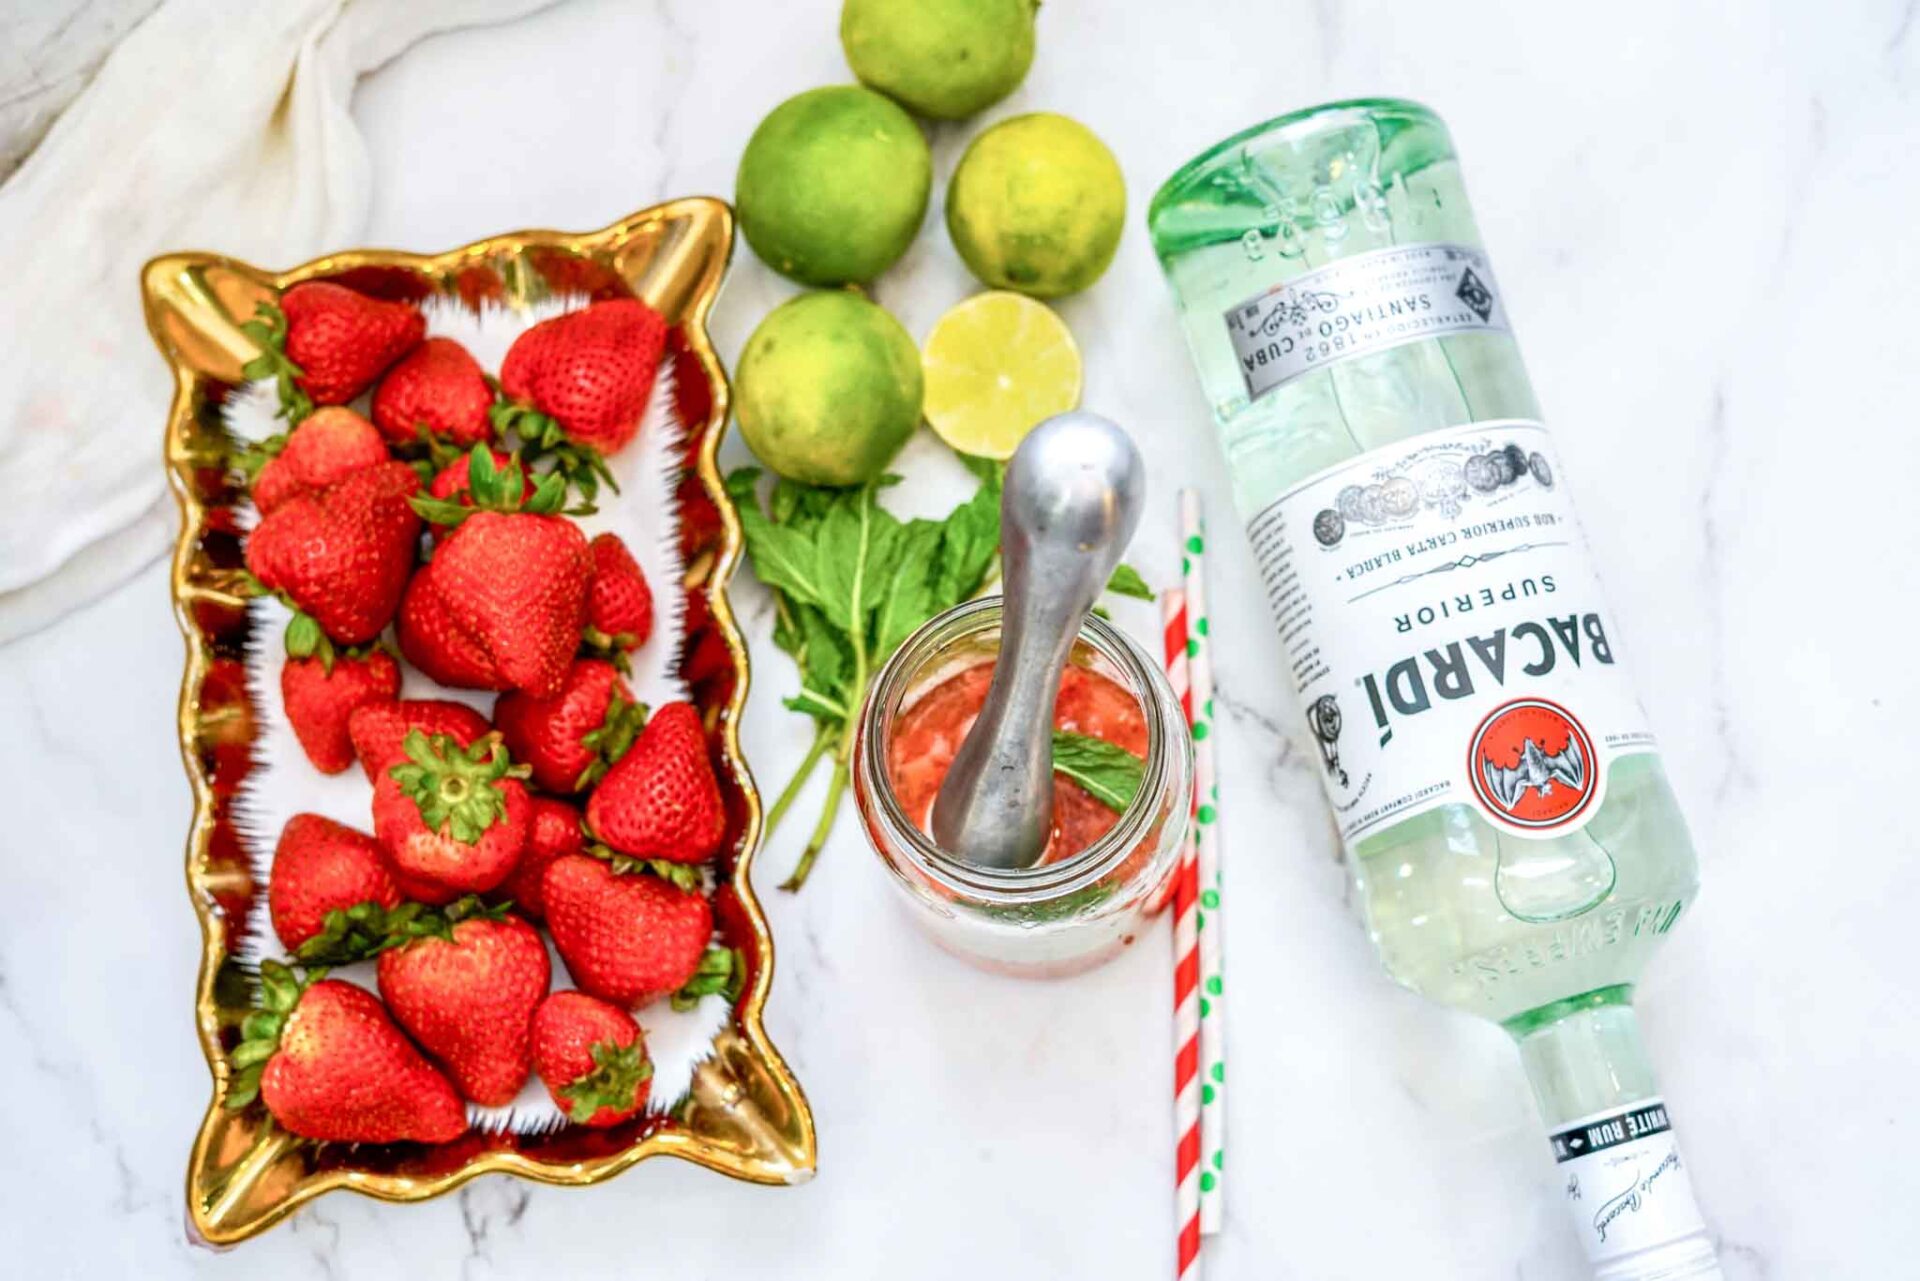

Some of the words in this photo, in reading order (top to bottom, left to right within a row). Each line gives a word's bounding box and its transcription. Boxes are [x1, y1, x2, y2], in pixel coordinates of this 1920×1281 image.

[1319, 293, 1431, 338] SANTIAGO
[1243, 336, 1295, 371] CUBA
[1305, 332, 1358, 362] 1862
[1462, 516, 1532, 539] SUPERIOR
[1406, 530, 1458, 557] CARTA
[1346, 549, 1402, 580] BLANCA
[1394, 574, 1557, 633] SUPERIOR
[1363, 613, 1615, 749] BACARDÍ
[1588, 1119, 1625, 1147] RUM
[1626, 1108, 1668, 1137] WHITE
